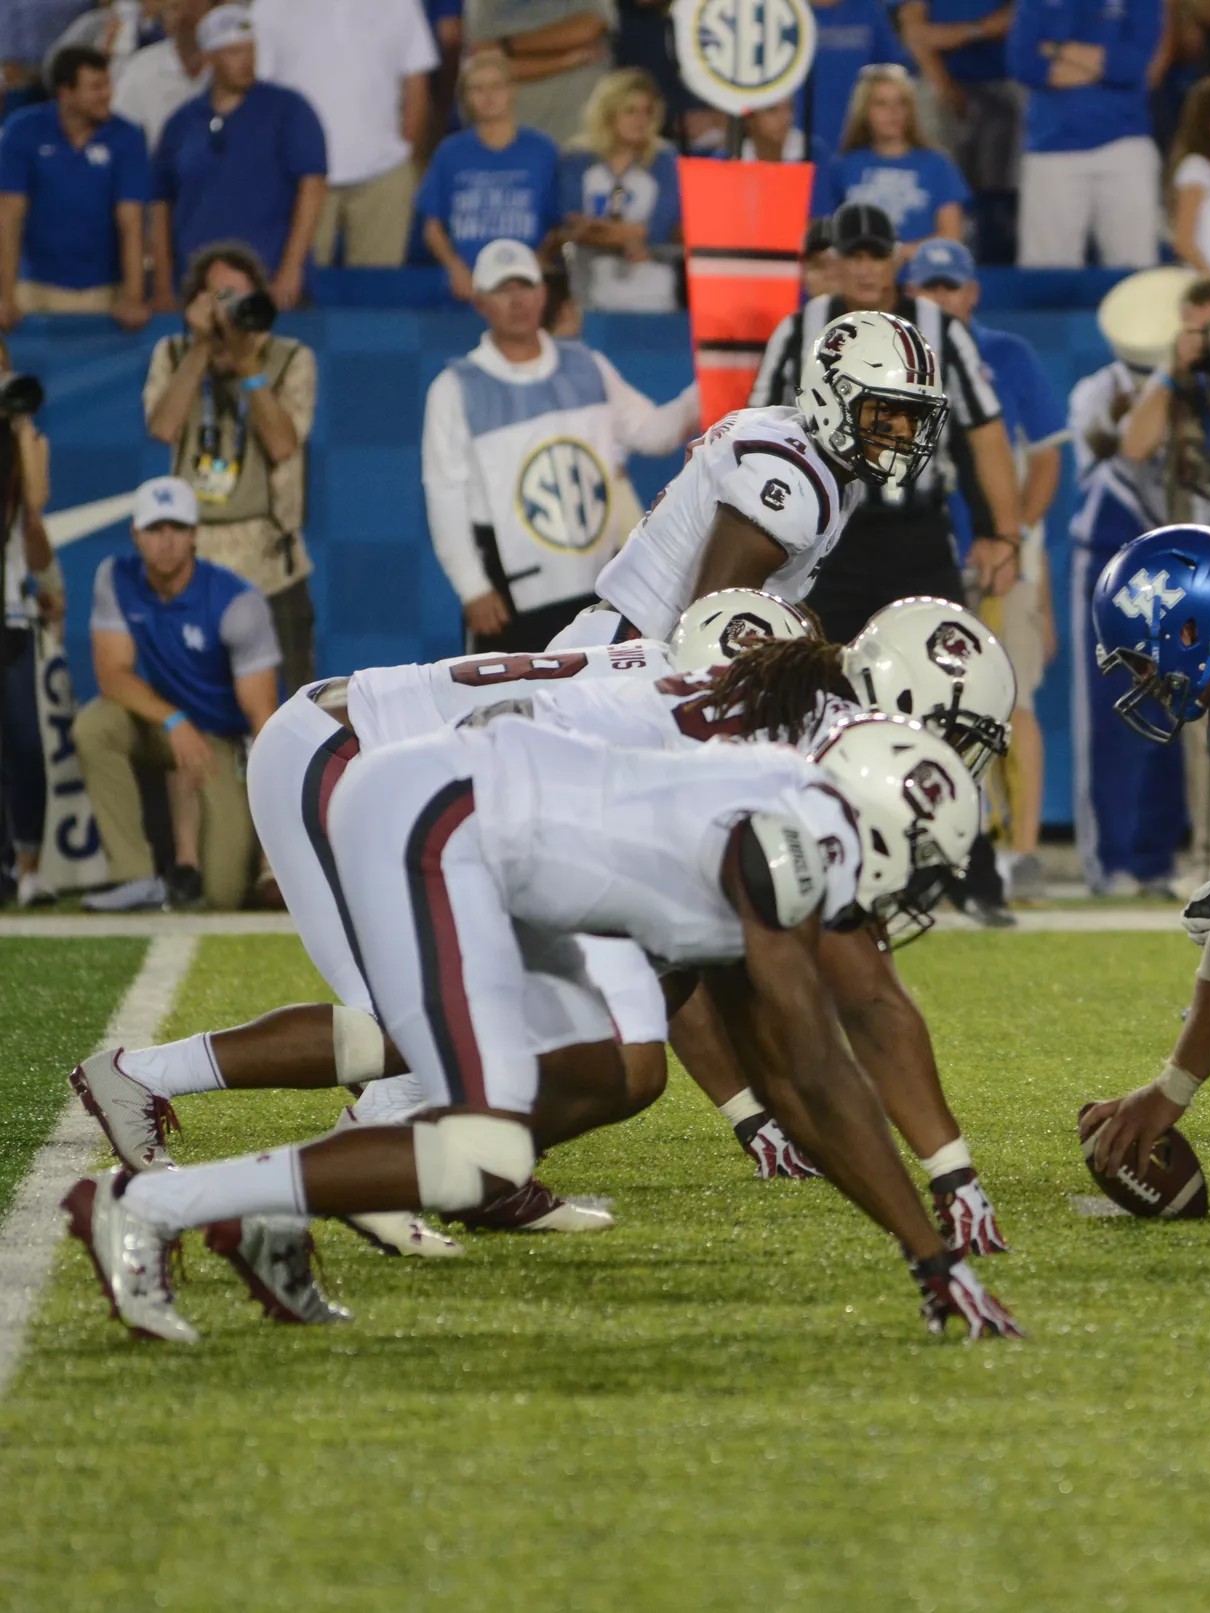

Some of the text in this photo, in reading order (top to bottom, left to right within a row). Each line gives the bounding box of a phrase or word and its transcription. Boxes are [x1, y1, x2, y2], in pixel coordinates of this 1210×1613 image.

[700, 0, 797, 83] SEC
[523, 444, 607, 549] SEC
[1111, 567, 1187, 628] UK
